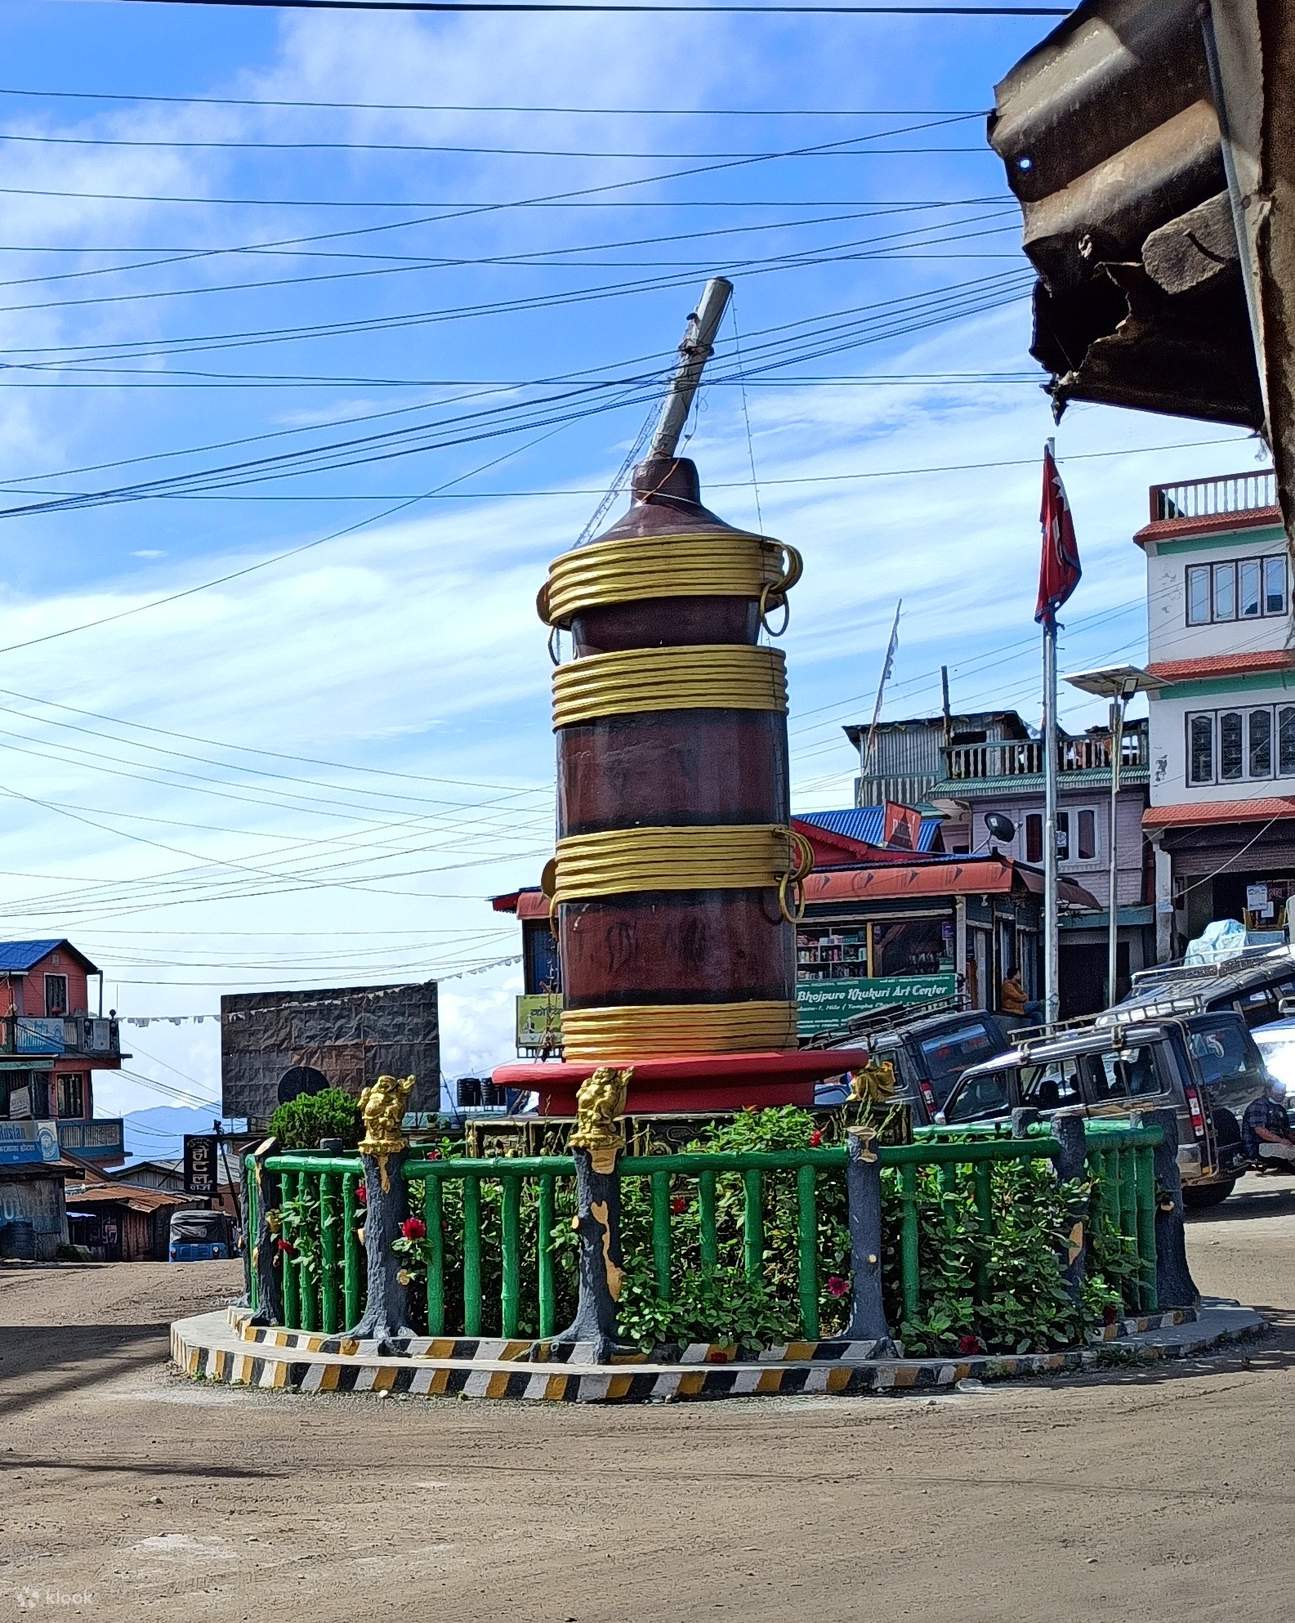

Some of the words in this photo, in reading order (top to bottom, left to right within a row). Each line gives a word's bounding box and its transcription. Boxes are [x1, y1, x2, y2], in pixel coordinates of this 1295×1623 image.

[848, 988, 890, 1000] Khukuri
[892, 985, 911, 996] Art
[912, 985, 948, 997] Center
